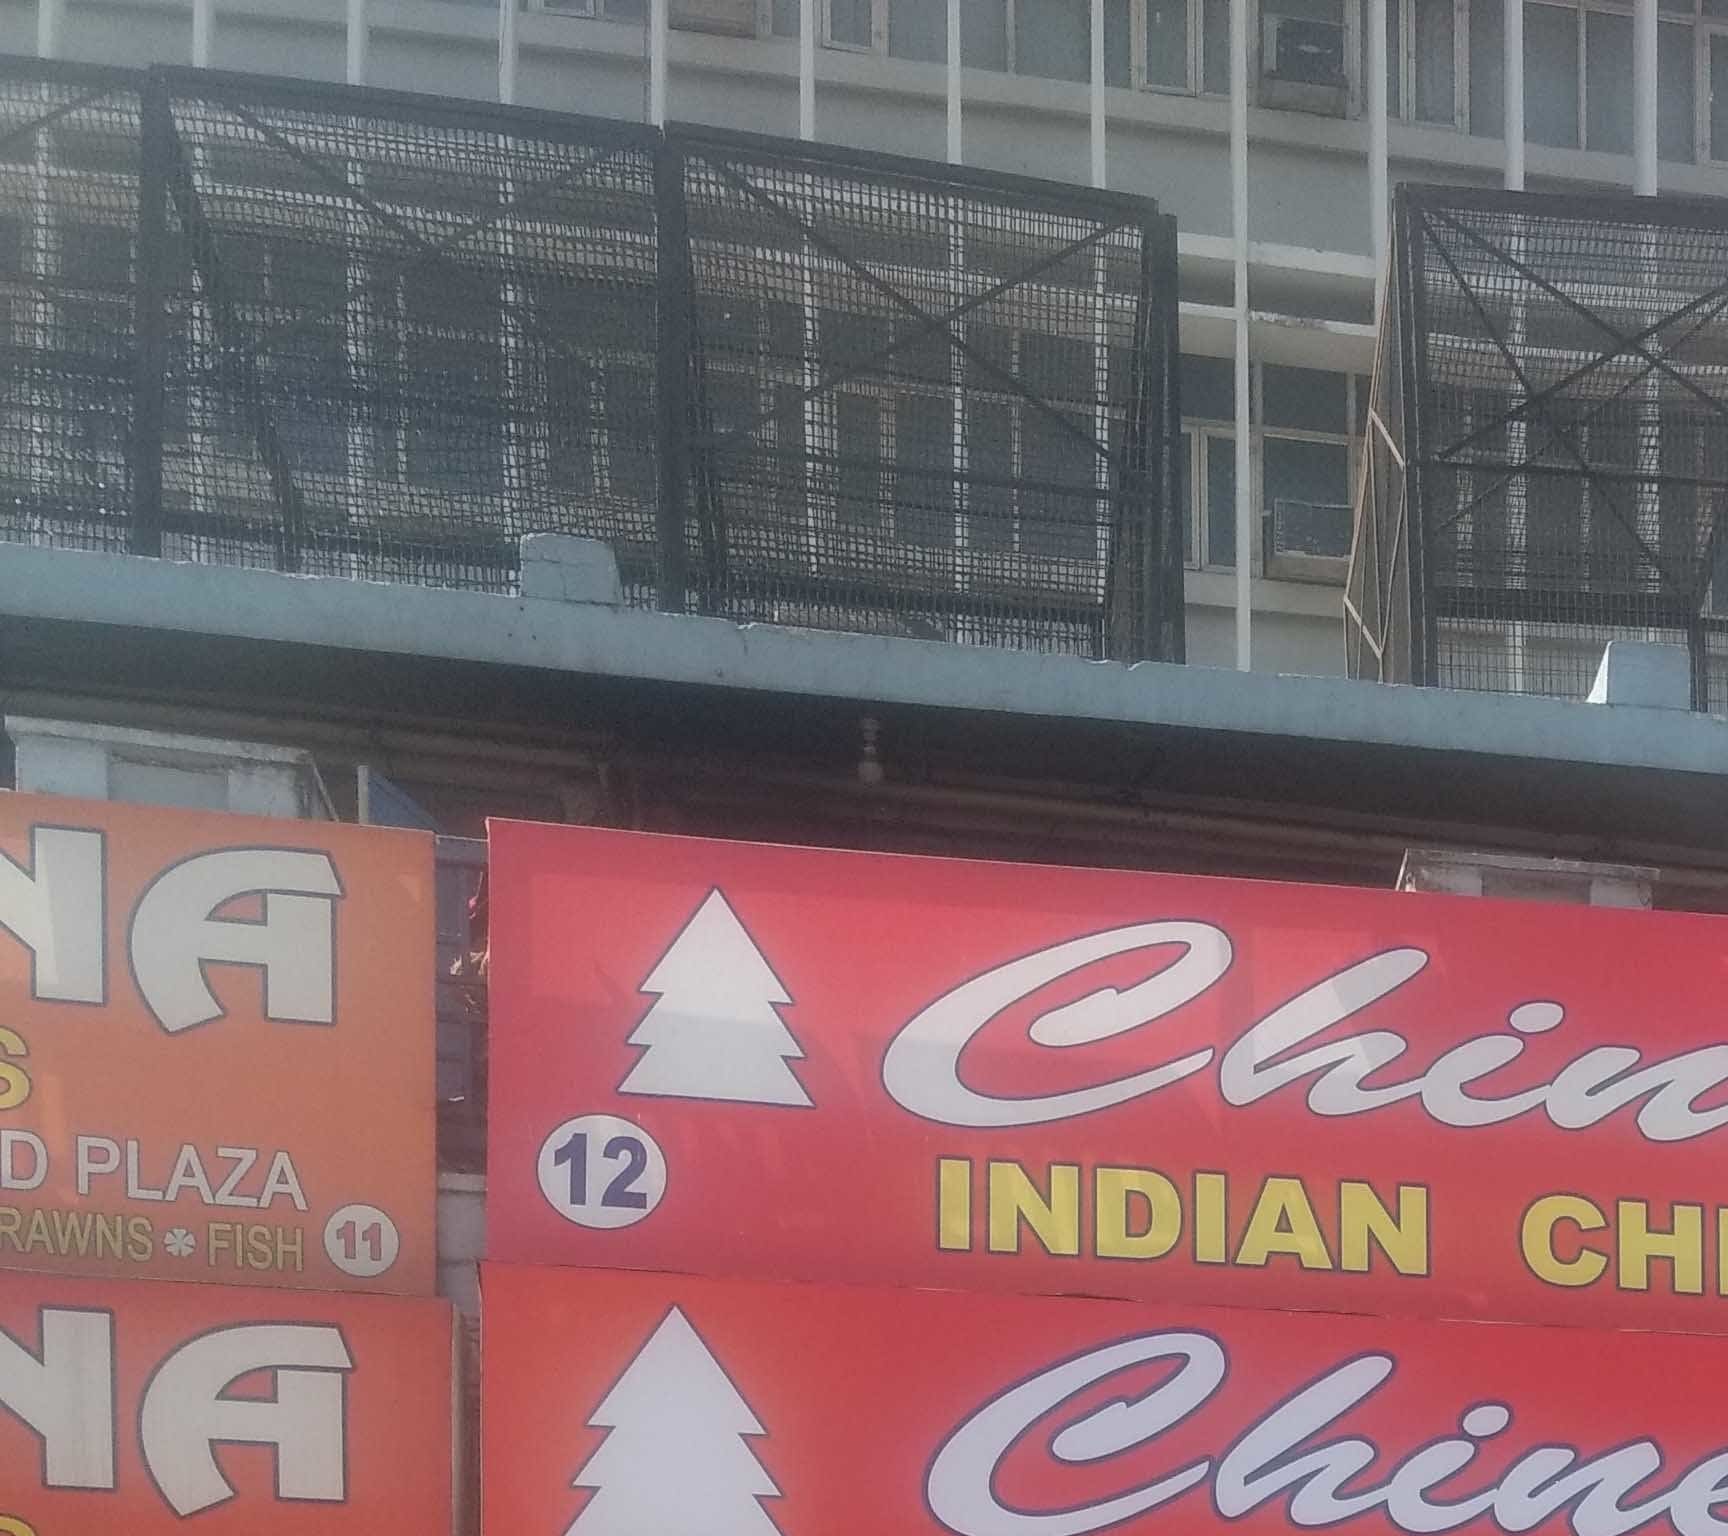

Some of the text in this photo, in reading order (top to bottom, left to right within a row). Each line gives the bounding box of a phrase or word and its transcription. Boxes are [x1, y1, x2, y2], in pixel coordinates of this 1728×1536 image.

[75, 1134, 308, 1211] PLAZA
[553, 1132, 649, 1211] 12
[208, 1225, 305, 1272] FISH
[335, 1220, 385, 1263] 11
[937, 1157, 1429, 1277] INDIAN
